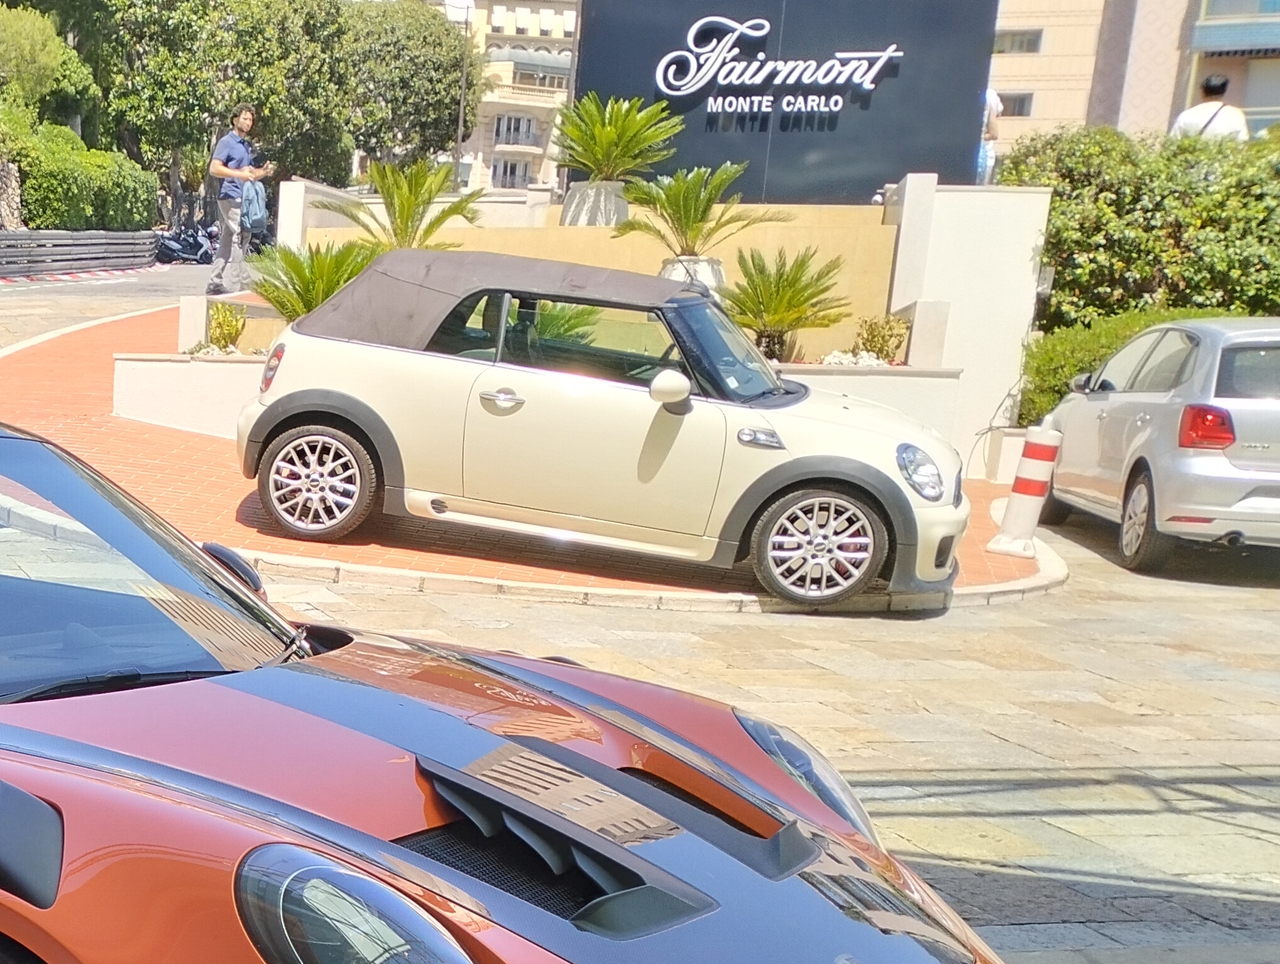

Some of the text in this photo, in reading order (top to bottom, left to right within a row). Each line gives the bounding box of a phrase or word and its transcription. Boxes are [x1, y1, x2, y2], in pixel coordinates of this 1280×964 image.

[656, 16, 904, 96] Fairmont
[706, 95, 844, 113] MONTE CARLO
